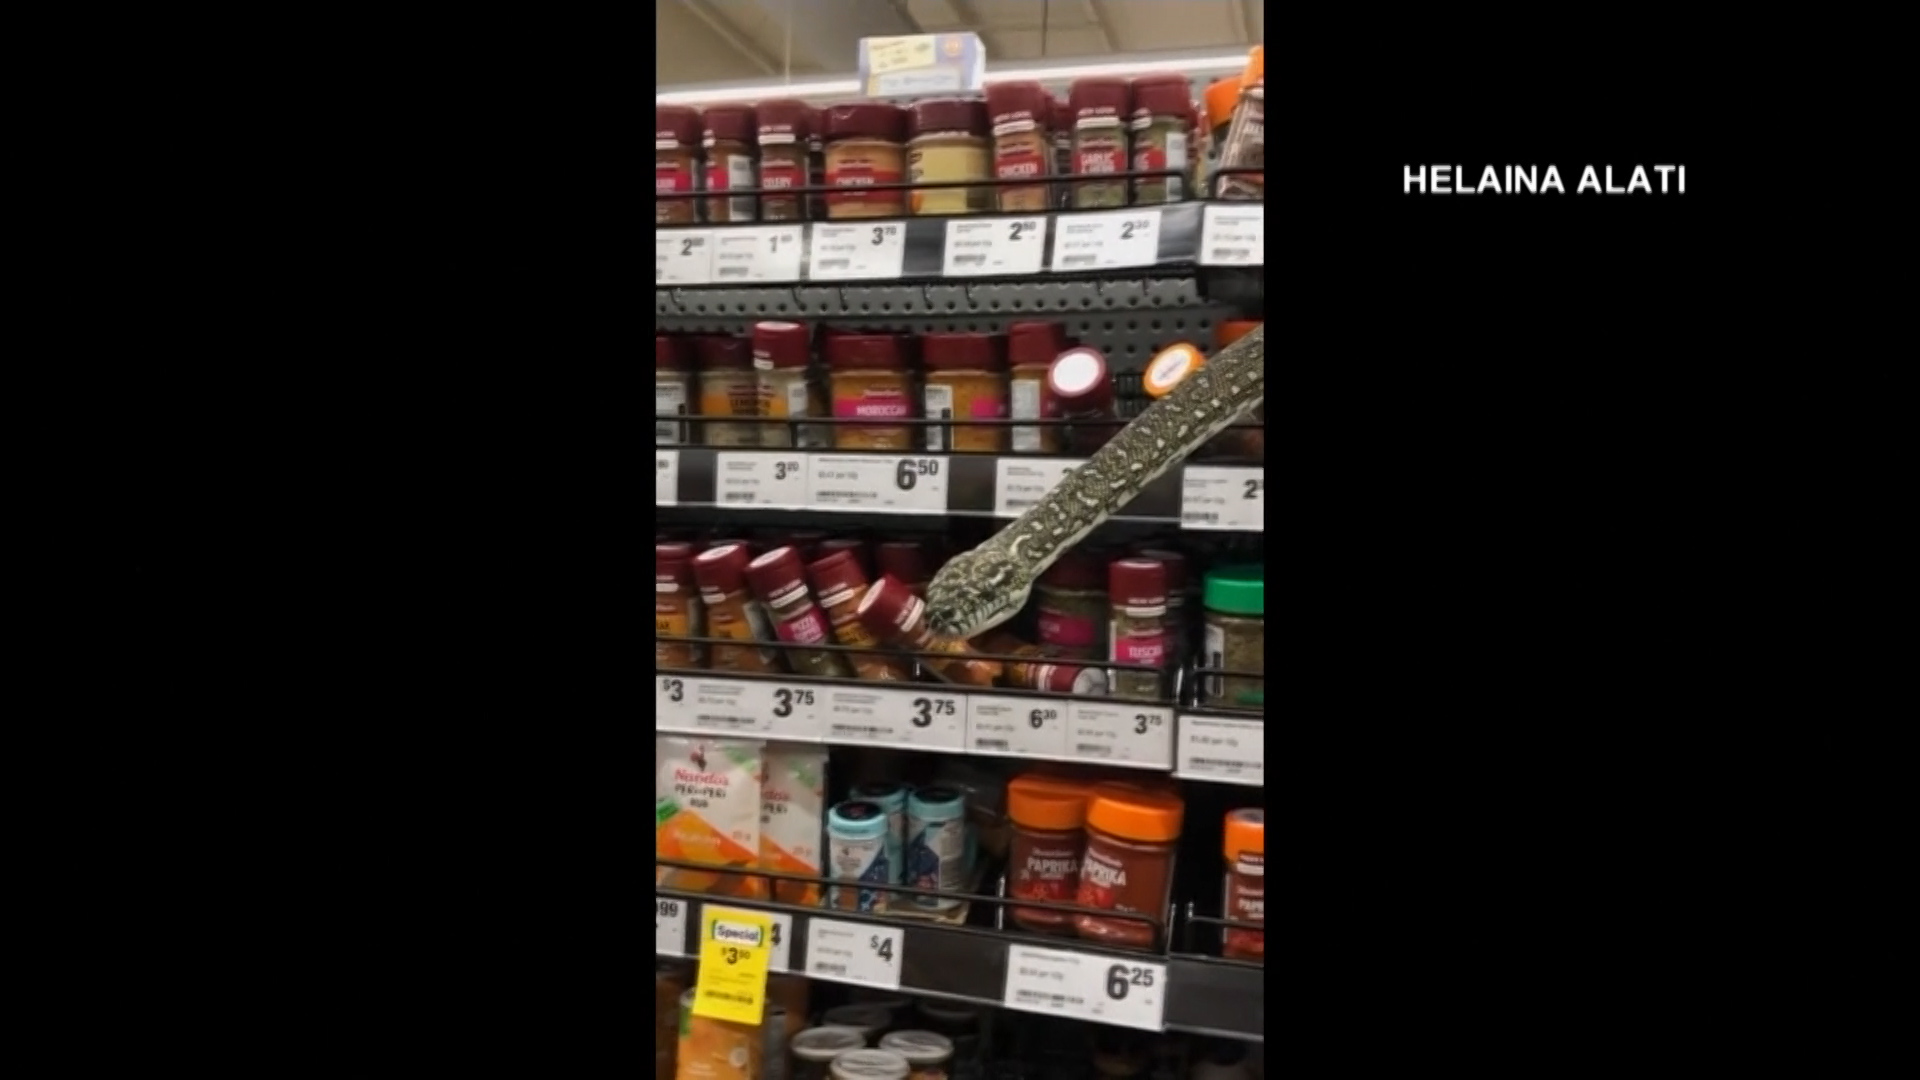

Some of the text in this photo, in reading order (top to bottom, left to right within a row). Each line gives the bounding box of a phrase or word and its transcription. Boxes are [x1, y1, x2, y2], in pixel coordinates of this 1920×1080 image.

[662, 678, 684, 702] $3
[870, 934, 893, 962] $4
[1106, 963, 1154, 1000] 625
